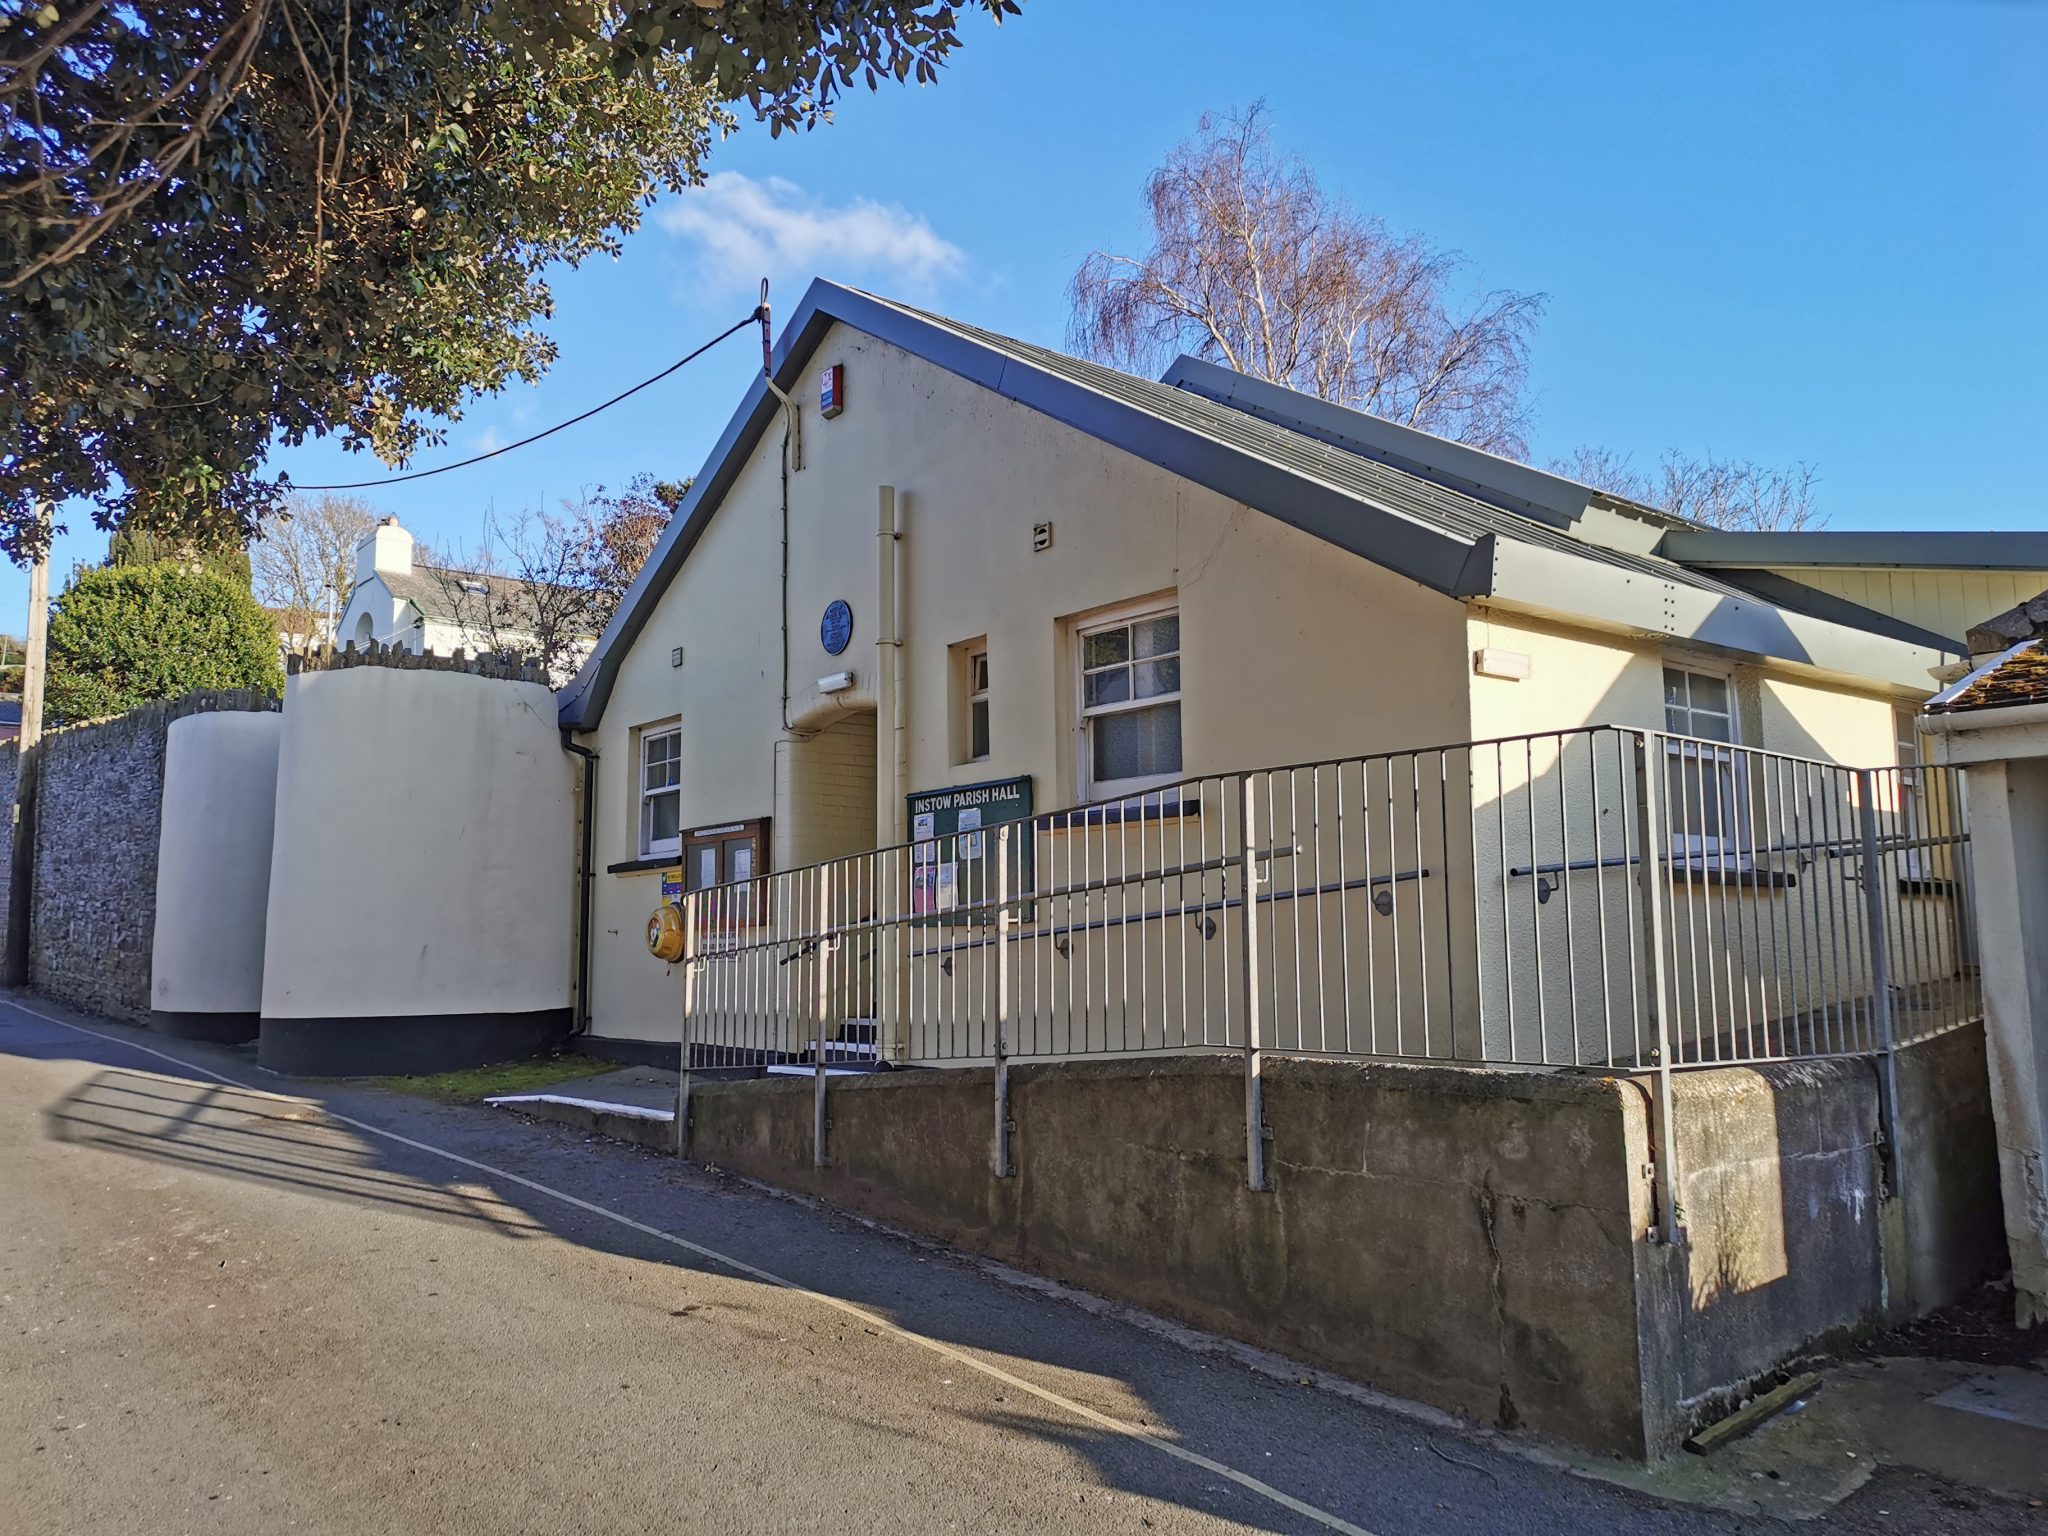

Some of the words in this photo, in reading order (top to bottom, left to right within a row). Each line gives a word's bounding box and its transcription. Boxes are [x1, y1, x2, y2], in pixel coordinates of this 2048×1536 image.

[915, 795, 952, 813] INSTOW
[953, 789, 990, 808] PARISH
[991, 784, 1020, 801] HALL
